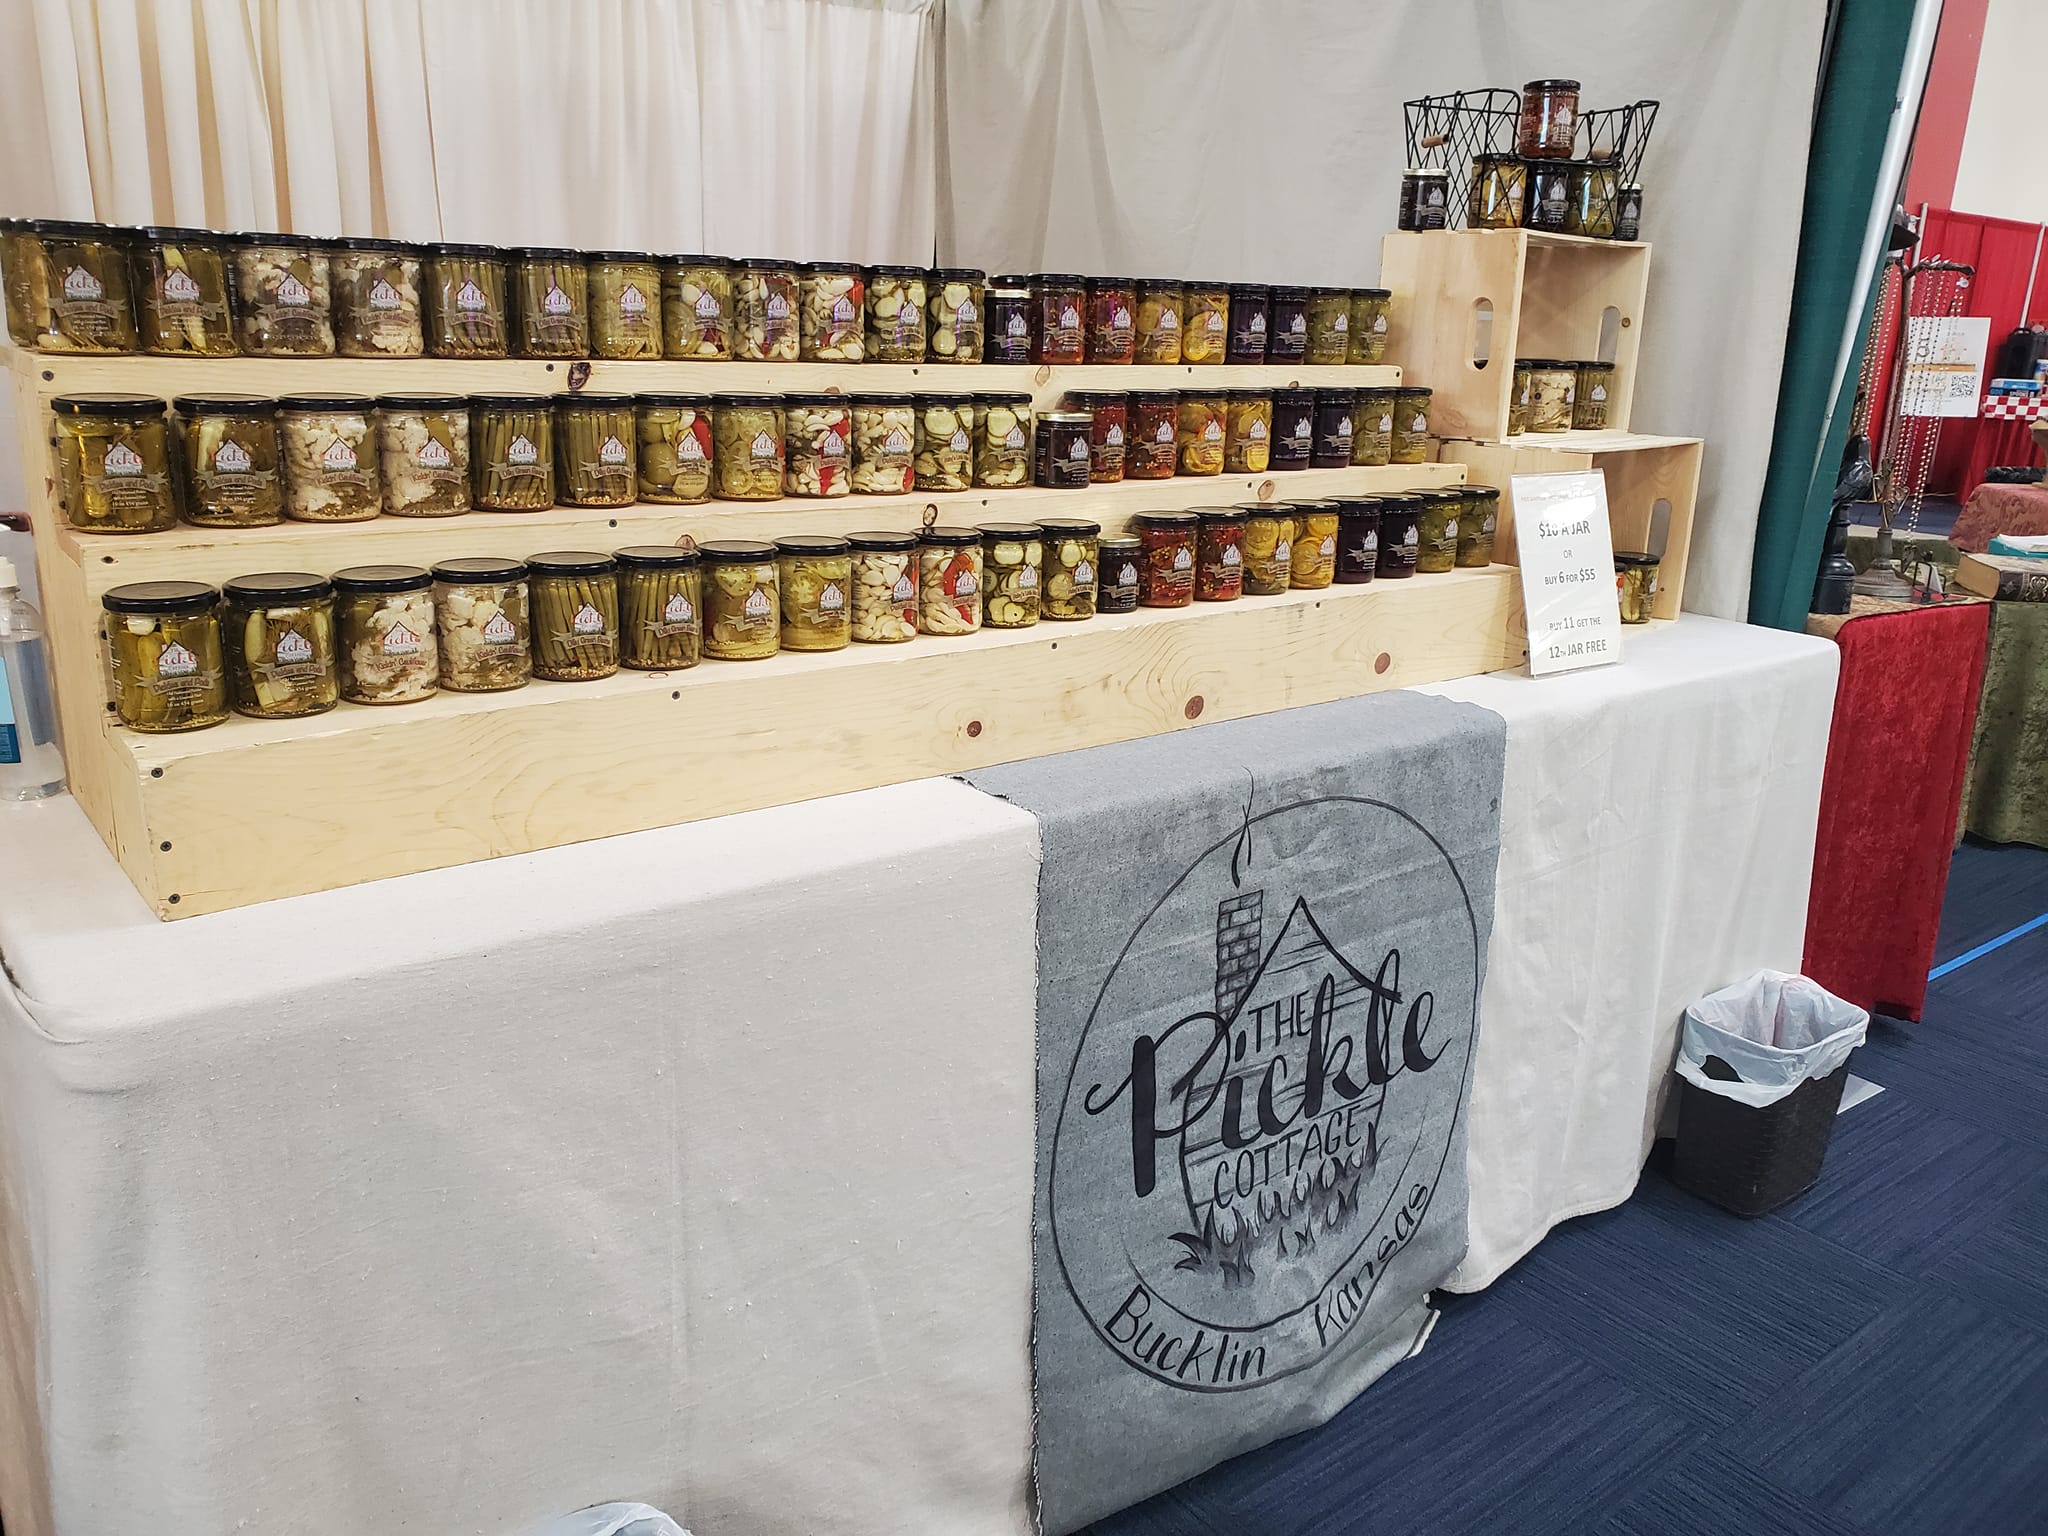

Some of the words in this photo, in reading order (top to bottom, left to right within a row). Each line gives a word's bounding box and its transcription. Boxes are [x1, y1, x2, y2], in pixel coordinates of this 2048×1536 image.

[1571, 520, 1591, 535] JAR
[1563, 549, 1573, 559] OR
[1544, 575, 1558, 585] BUY
[1558, 571, 1565, 583] 6
[1566, 573, 1579, 583] FOR
[1579, 568, 1596, 583] $55
[1563, 616, 1574, 629] 11
[1576, 618, 1588, 627] GET
[1589, 617, 1601, 626] THE
[1567, 643, 1584, 657] JAR
[1585, 639, 1607, 654] FREE
[1248, 990, 1309, 1053] THE
[1084, 948, 1452, 1198] Pickle
[1213, 1105, 1363, 1209] COTTAGE
[1103, 1284, 1266, 1383] Bucklin
[1314, 1184, 1428, 1348] Kansas
